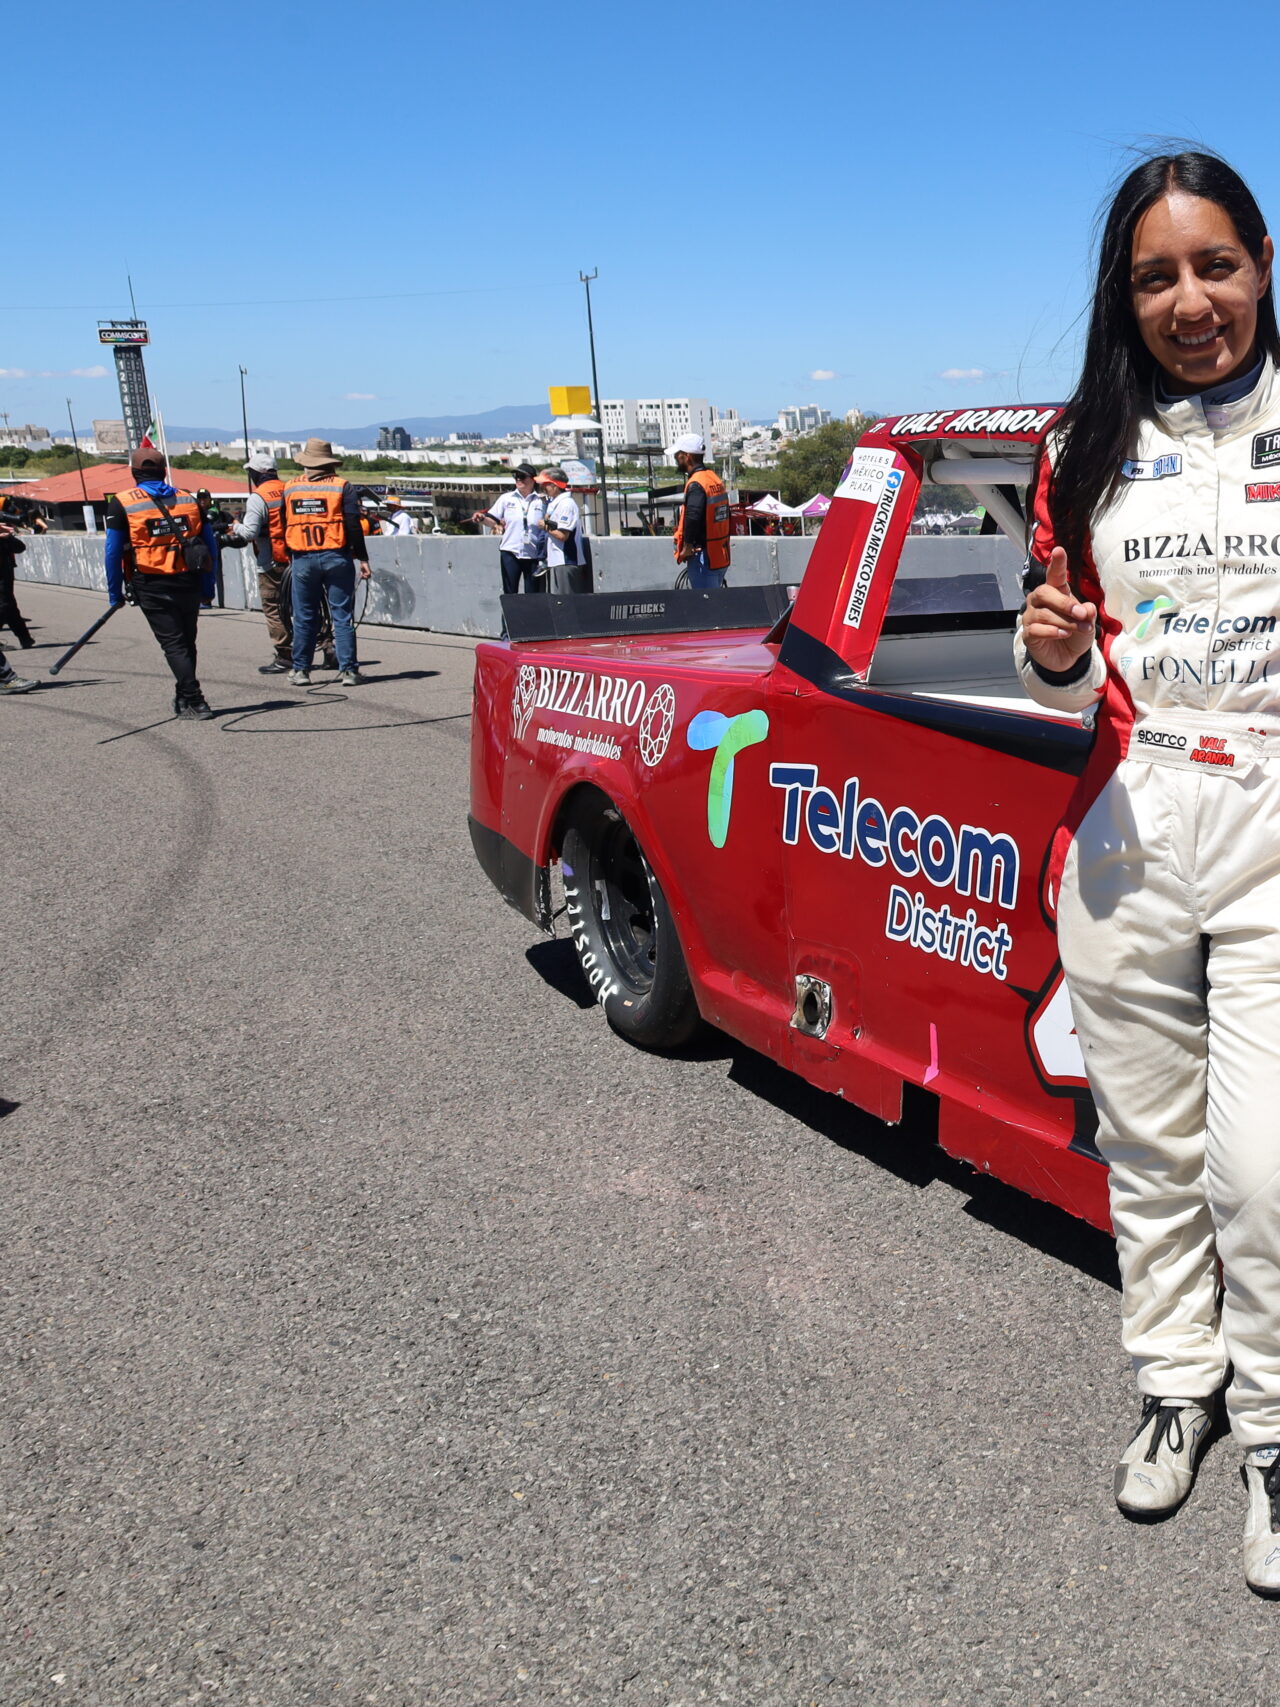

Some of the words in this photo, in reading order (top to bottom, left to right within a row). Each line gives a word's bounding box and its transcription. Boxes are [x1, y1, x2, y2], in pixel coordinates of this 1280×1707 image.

[101, 331, 146, 339] COMMSCOPE
[891, 411, 953, 435] VALE
[945, 409, 1058, 434] ARANDA
[853, 465, 884, 480] MÉXICO
[850, 481, 873, 493] PLAZA
[873, 487, 896, 535] TRUCKS
[303, 525, 325, 546] 10
[861, 535, 882, 582] MEXICO
[628, 603, 665, 614] TRUCKS
[848, 581, 868, 623] SERIES
[1159, 612, 1277, 635] Telecom
[1212, 638, 1271, 653] District
[536, 666, 646, 727] BIZZARRO
[537, 726, 574, 749] momentos
[1138, 729, 1187, 748] sparco
[1199, 736, 1227, 751] VALE
[1190, 750, 1236, 767] ARANDA
[769, 762, 1020, 910] Telecom
[885, 884, 1012, 981] District
